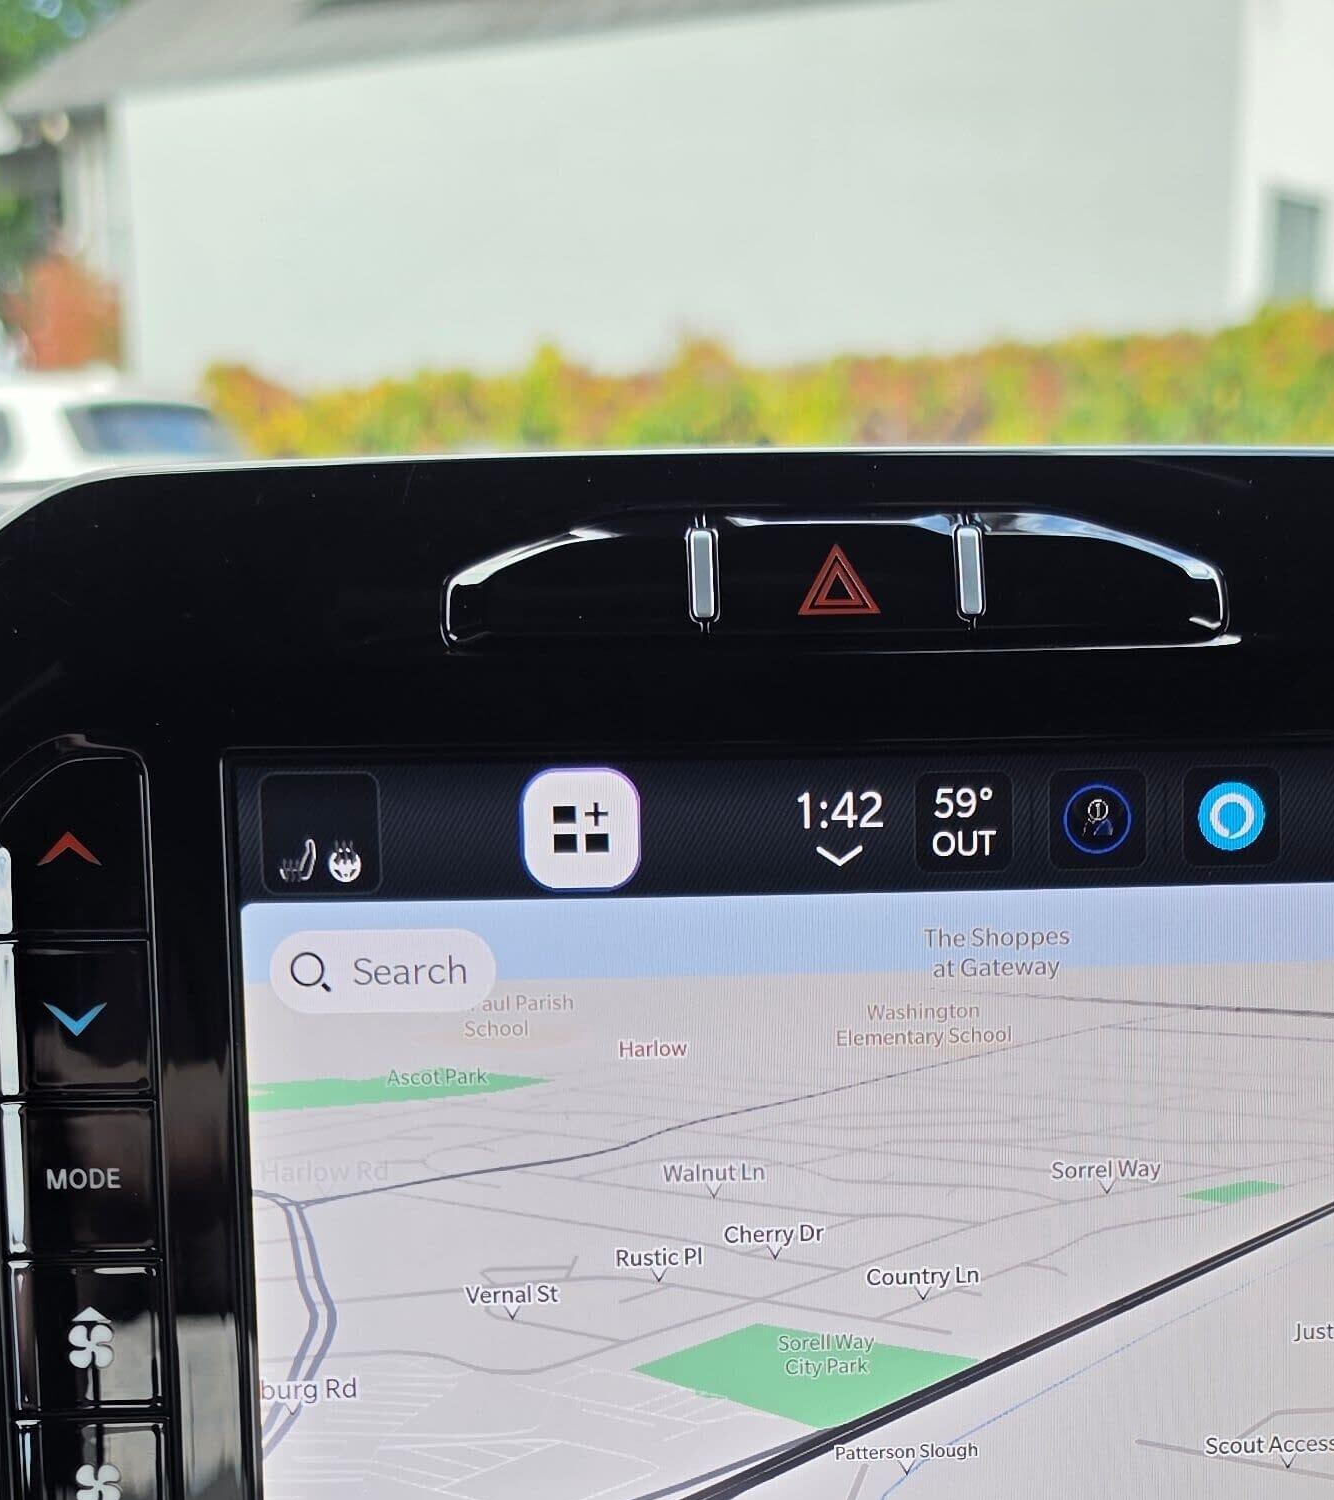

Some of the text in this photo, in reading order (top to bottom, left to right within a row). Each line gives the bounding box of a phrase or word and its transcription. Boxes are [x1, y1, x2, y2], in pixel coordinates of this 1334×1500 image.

[797, 792, 884, 830] 1:42
[932, 831, 997, 858] OUT
[924, 926, 1070, 952] The Shoppes
[352, 955, 468, 988] Search
[933, 957, 1060, 982] at Gateway
[481, 994, 510, 1012] aul
[516, 993, 574, 1012] Parish
[867, 1003, 980, 1026] Washington
[464, 1019, 529, 1038] School
[836, 1025, 1012, 1049] Elementary School
[619, 1039, 688, 1058] Harlow
[386, 1068, 487, 1087] Ascot Park
[46, 1167, 122, 1190] MODE
[663, 1163, 765, 1184] Walnut Ln
[1051, 1159, 1161, 1184] Sorrel Way
[724, 1224, 825, 1247] Cherry Dr
[616, 1248, 703, 1268] Rustic Pl
[867, 1267, 979, 1288] Country Ln
[466, 1285, 559, 1304] Vernal St
[779, 1334, 875, 1352] Sorell Way
[786, 1359, 868, 1377] City Park
[326, 1378, 357, 1399] Rd
[835, 1443, 978, 1462] Patterson Slough
[1206, 1437, 1265, 1455] Scout
